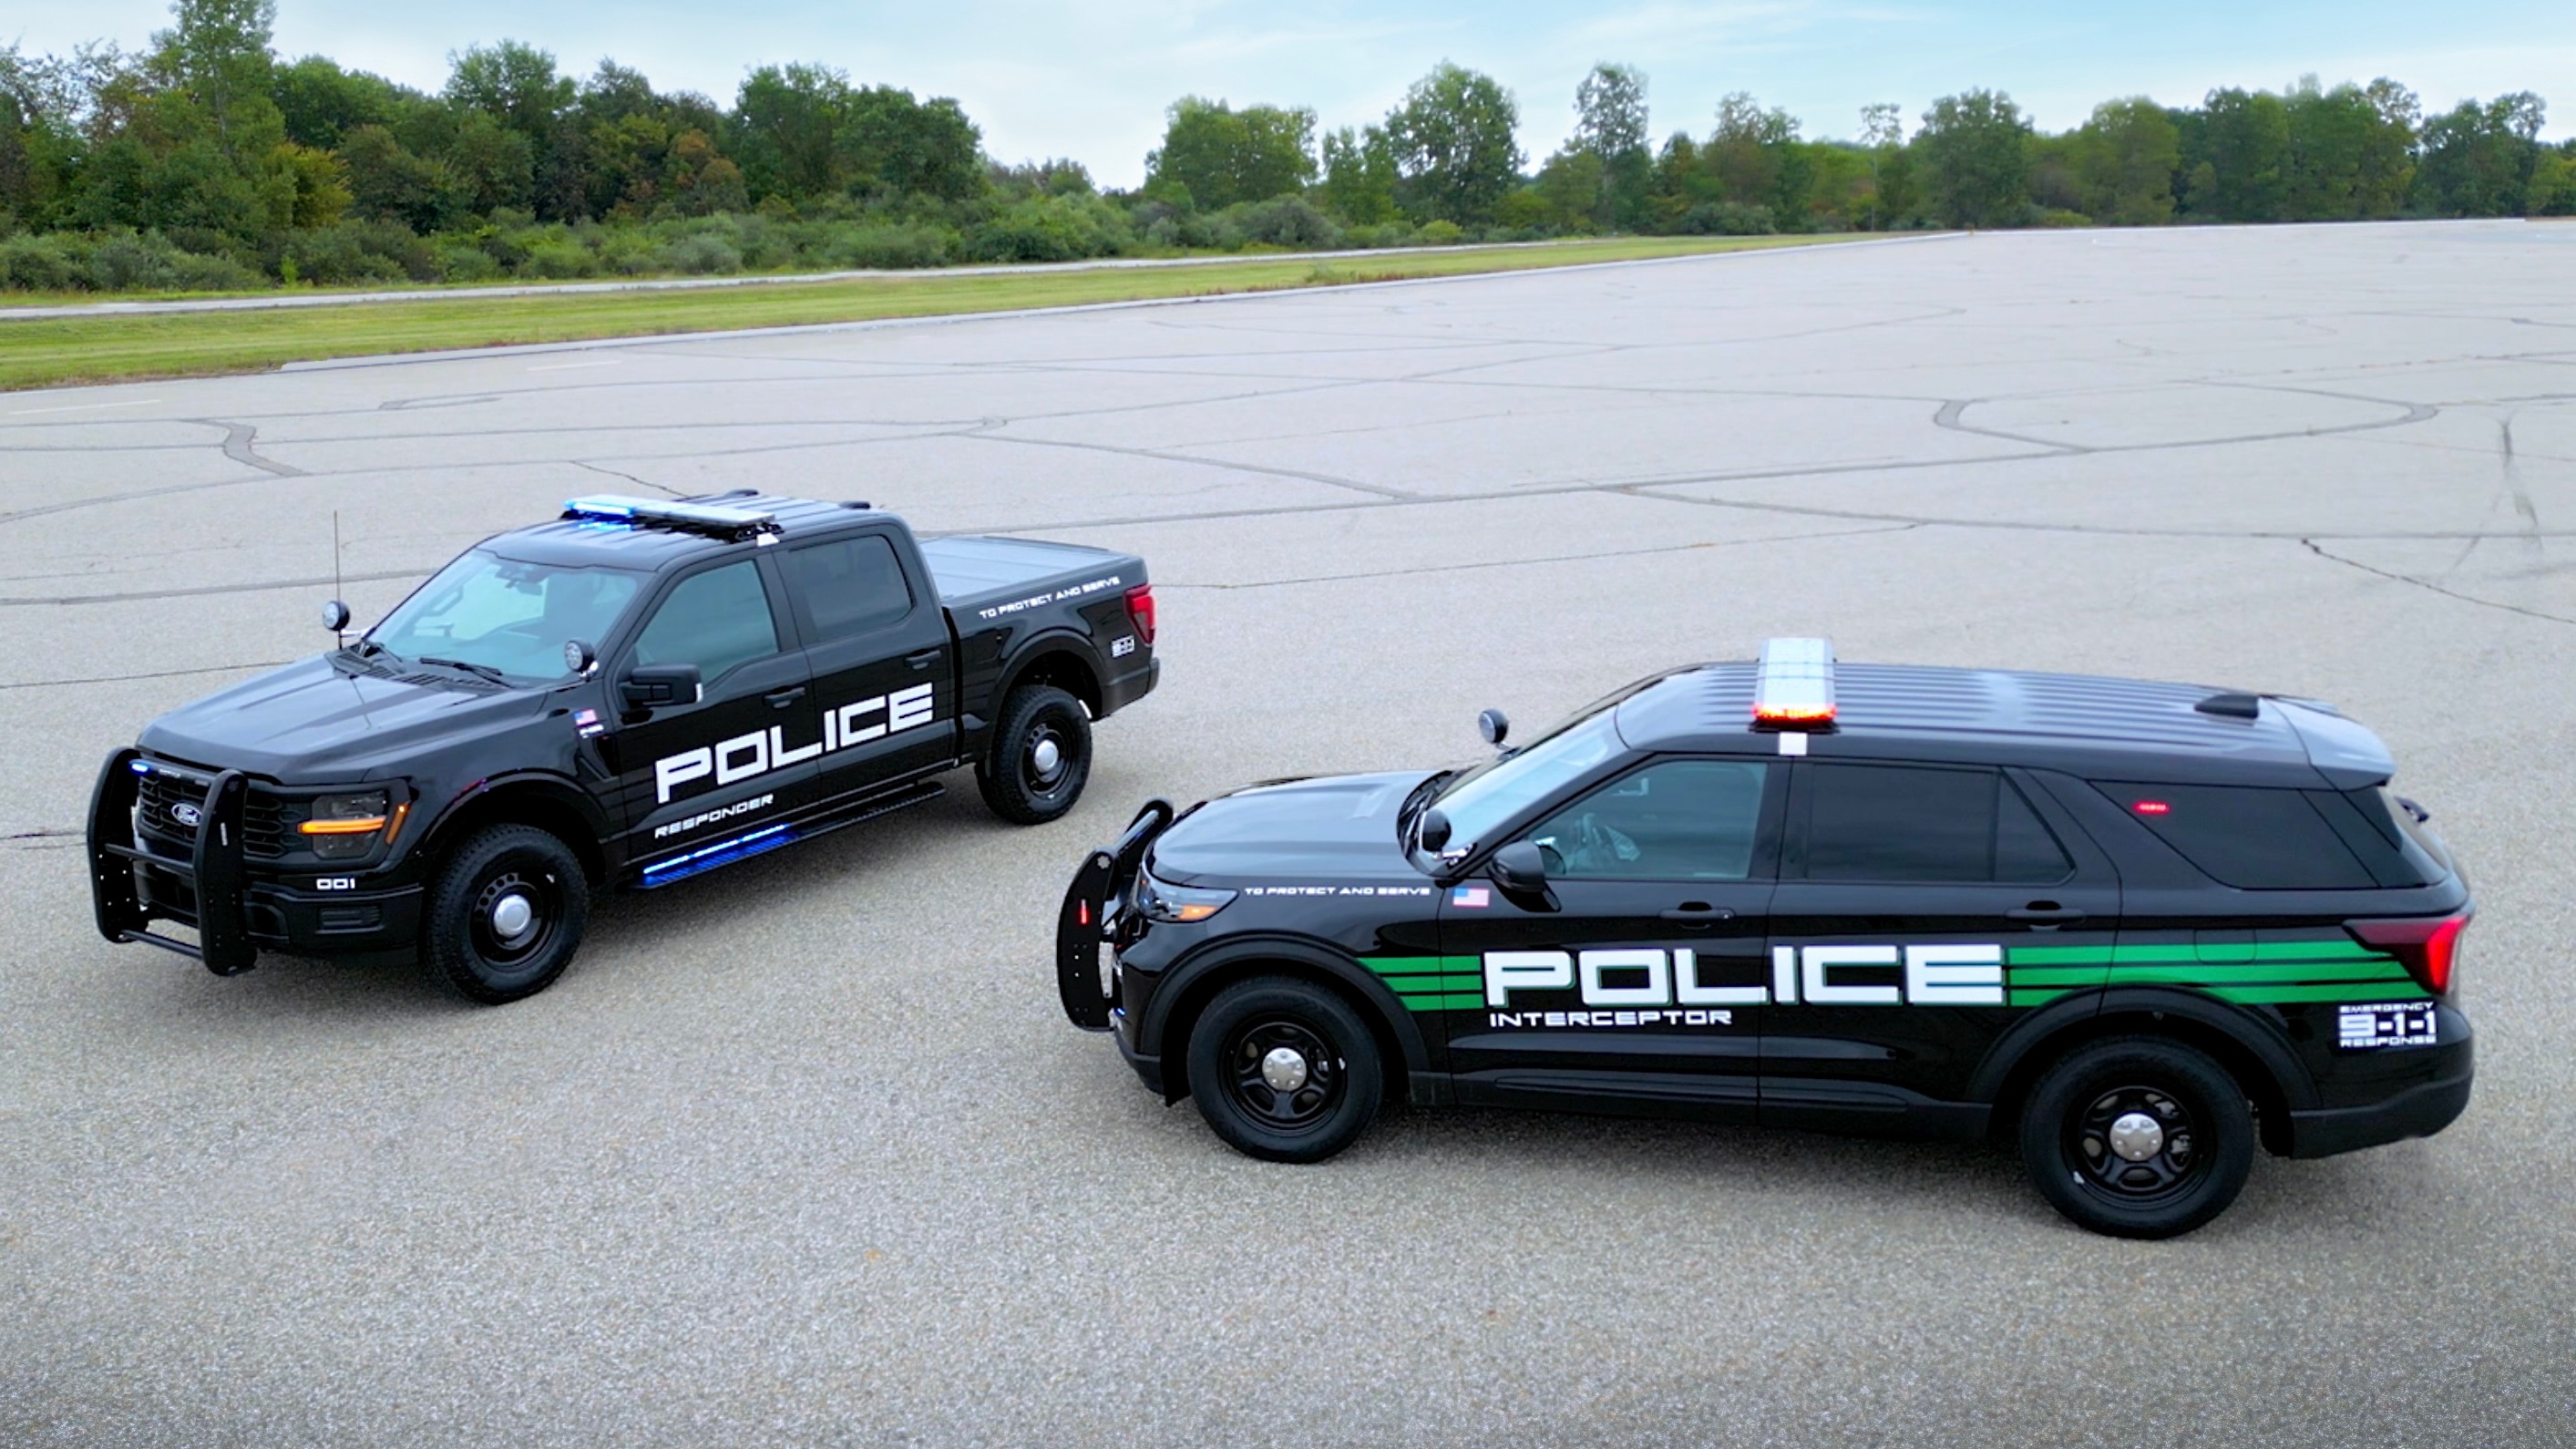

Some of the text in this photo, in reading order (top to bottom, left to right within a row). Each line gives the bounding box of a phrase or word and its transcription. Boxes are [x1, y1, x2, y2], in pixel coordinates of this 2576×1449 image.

[979, 576, 1121, 620] TO PROTECT AND SERVE
[654, 683, 934, 804] POLICE
[654, 794, 774, 839] RESPONDER
[316, 878, 355, 890] 001
[1245, 887, 1432, 897] TO PROTECT AND SERVE
[1483, 943, 2006, 1006] POLICE
[1490, 1009, 1732, 1027] INTERCEPTOR
[2339, 1002, 2434, 1014] EMERGENCY
